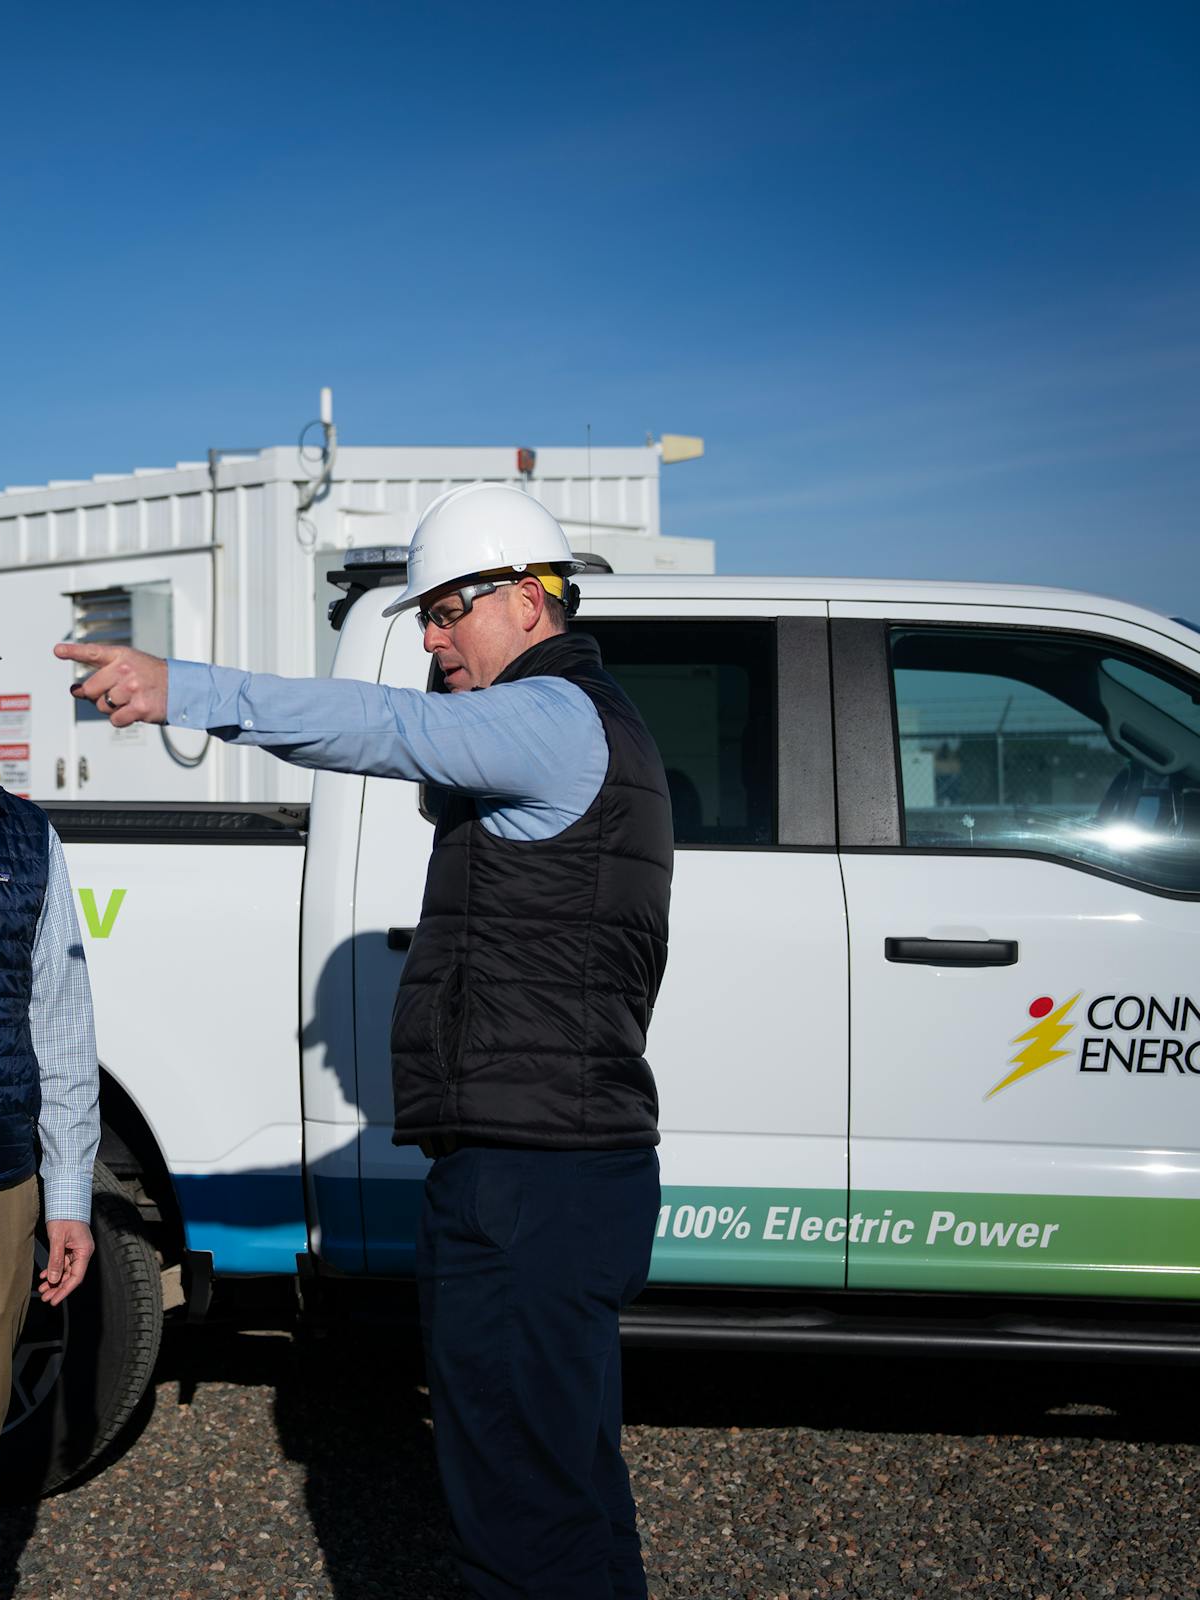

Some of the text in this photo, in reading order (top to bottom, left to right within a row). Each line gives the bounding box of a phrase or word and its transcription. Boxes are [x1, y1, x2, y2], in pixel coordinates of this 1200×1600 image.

[70, 888, 128, 938] V
[656, 1205, 1059, 1248] 100% Electric Power
